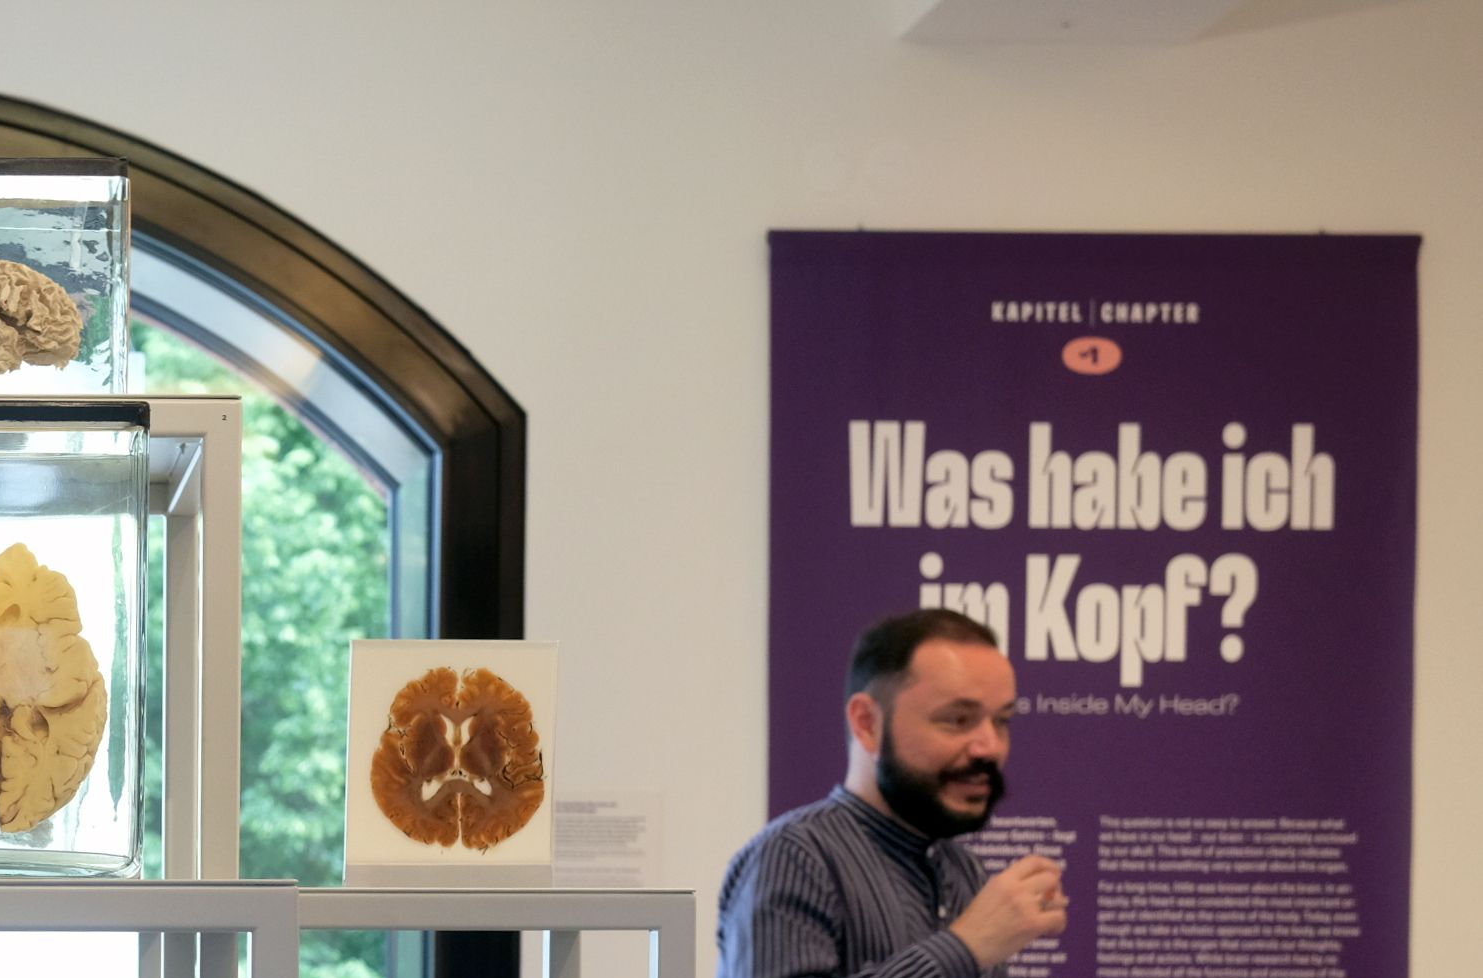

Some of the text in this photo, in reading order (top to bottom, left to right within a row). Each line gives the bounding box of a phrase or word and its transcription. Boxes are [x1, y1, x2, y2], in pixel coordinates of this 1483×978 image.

[992, 302, 1198, 323] KAPITEL CHAPTER
[849, 421, 1334, 531] Was habe ich
[1025, 554, 1257, 687] Kopf?
[1037, 694, 1109, 714] Inside
[1115, 694, 1153, 718] My
[1159, 694, 1238, 715] Head?
